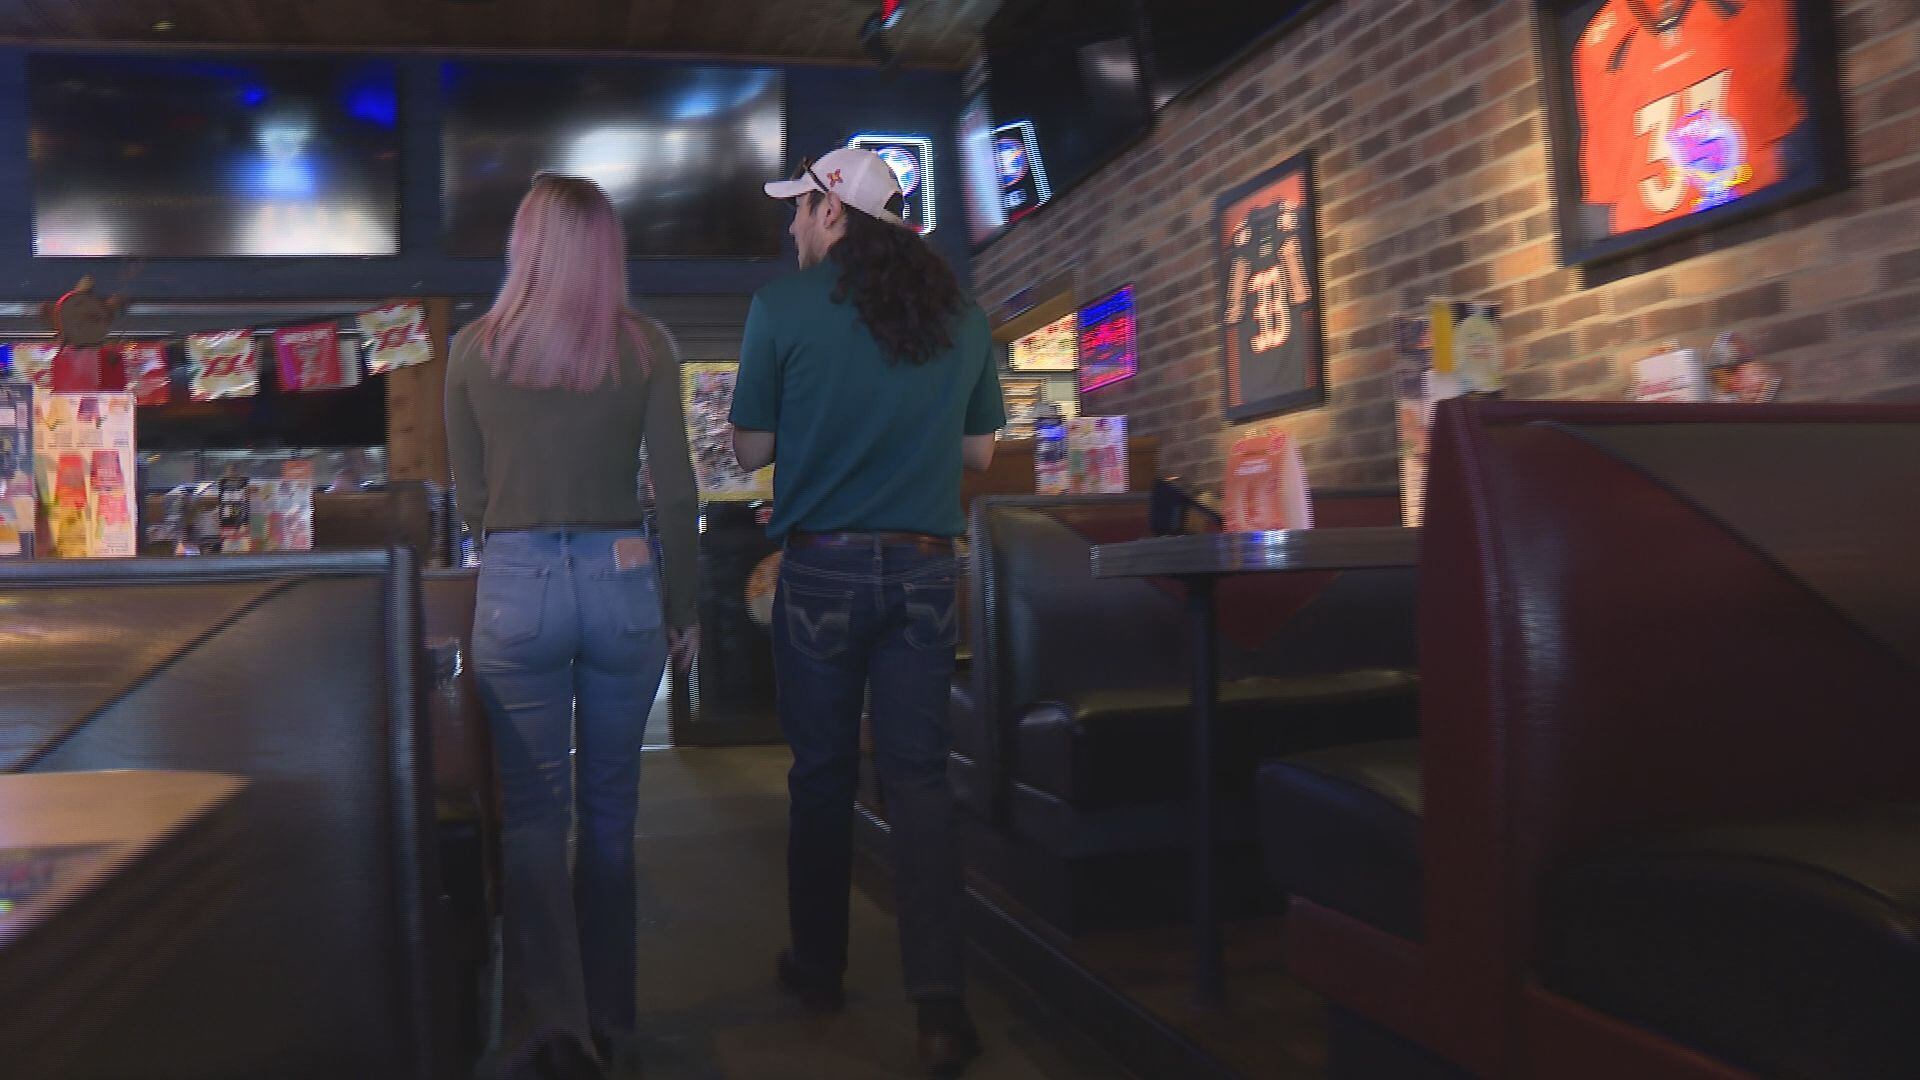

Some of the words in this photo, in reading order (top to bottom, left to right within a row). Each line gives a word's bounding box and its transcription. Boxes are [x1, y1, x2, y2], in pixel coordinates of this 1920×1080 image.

[1246, 264, 1291, 354] 33
[372, 324, 412, 354] XX
[199, 354, 243, 379] XX
